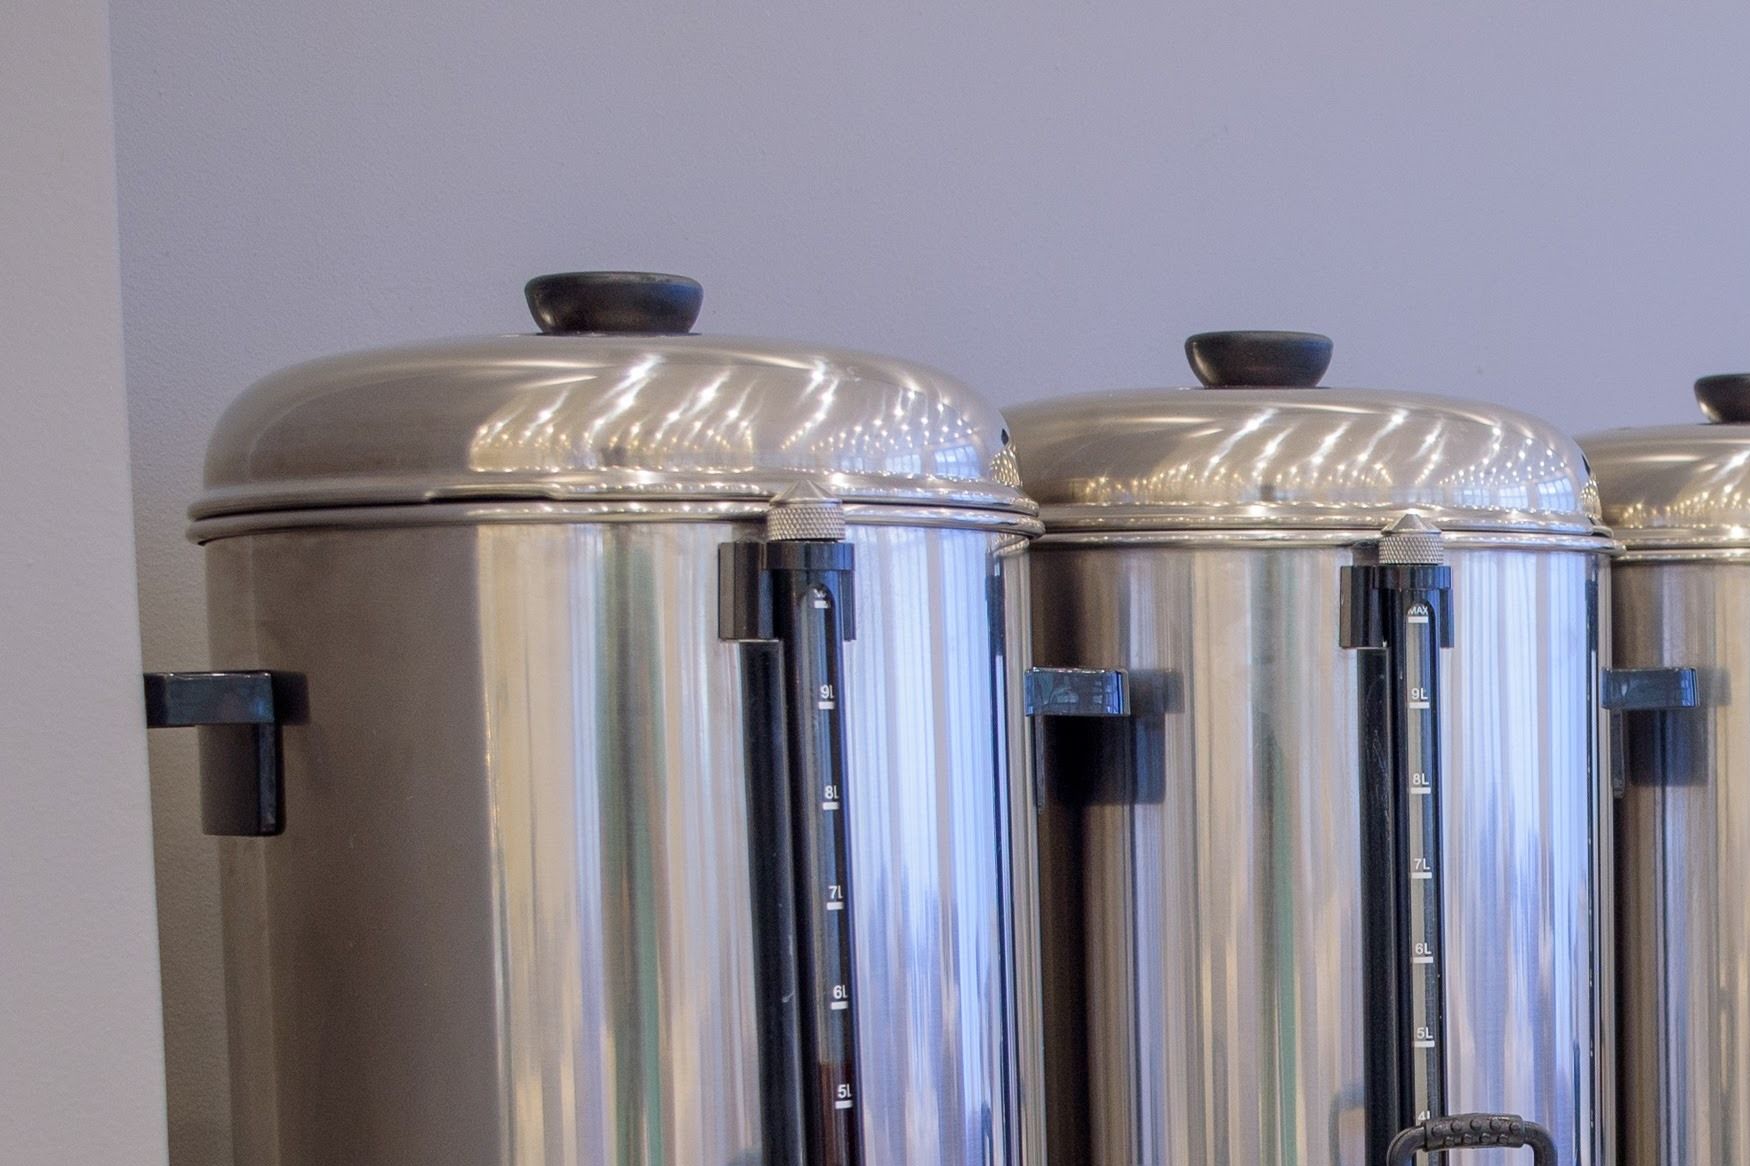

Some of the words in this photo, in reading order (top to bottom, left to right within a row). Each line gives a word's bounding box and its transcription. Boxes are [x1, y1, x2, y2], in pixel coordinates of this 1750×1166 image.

[1411, 688, 1428, 700] 9L
[1413, 773, 1429, 785] 8L
[1414, 858, 1430, 870] 7L
[1415, 943, 1432, 955] 6L
[1417, 1027, 1433, 1039] 5L
